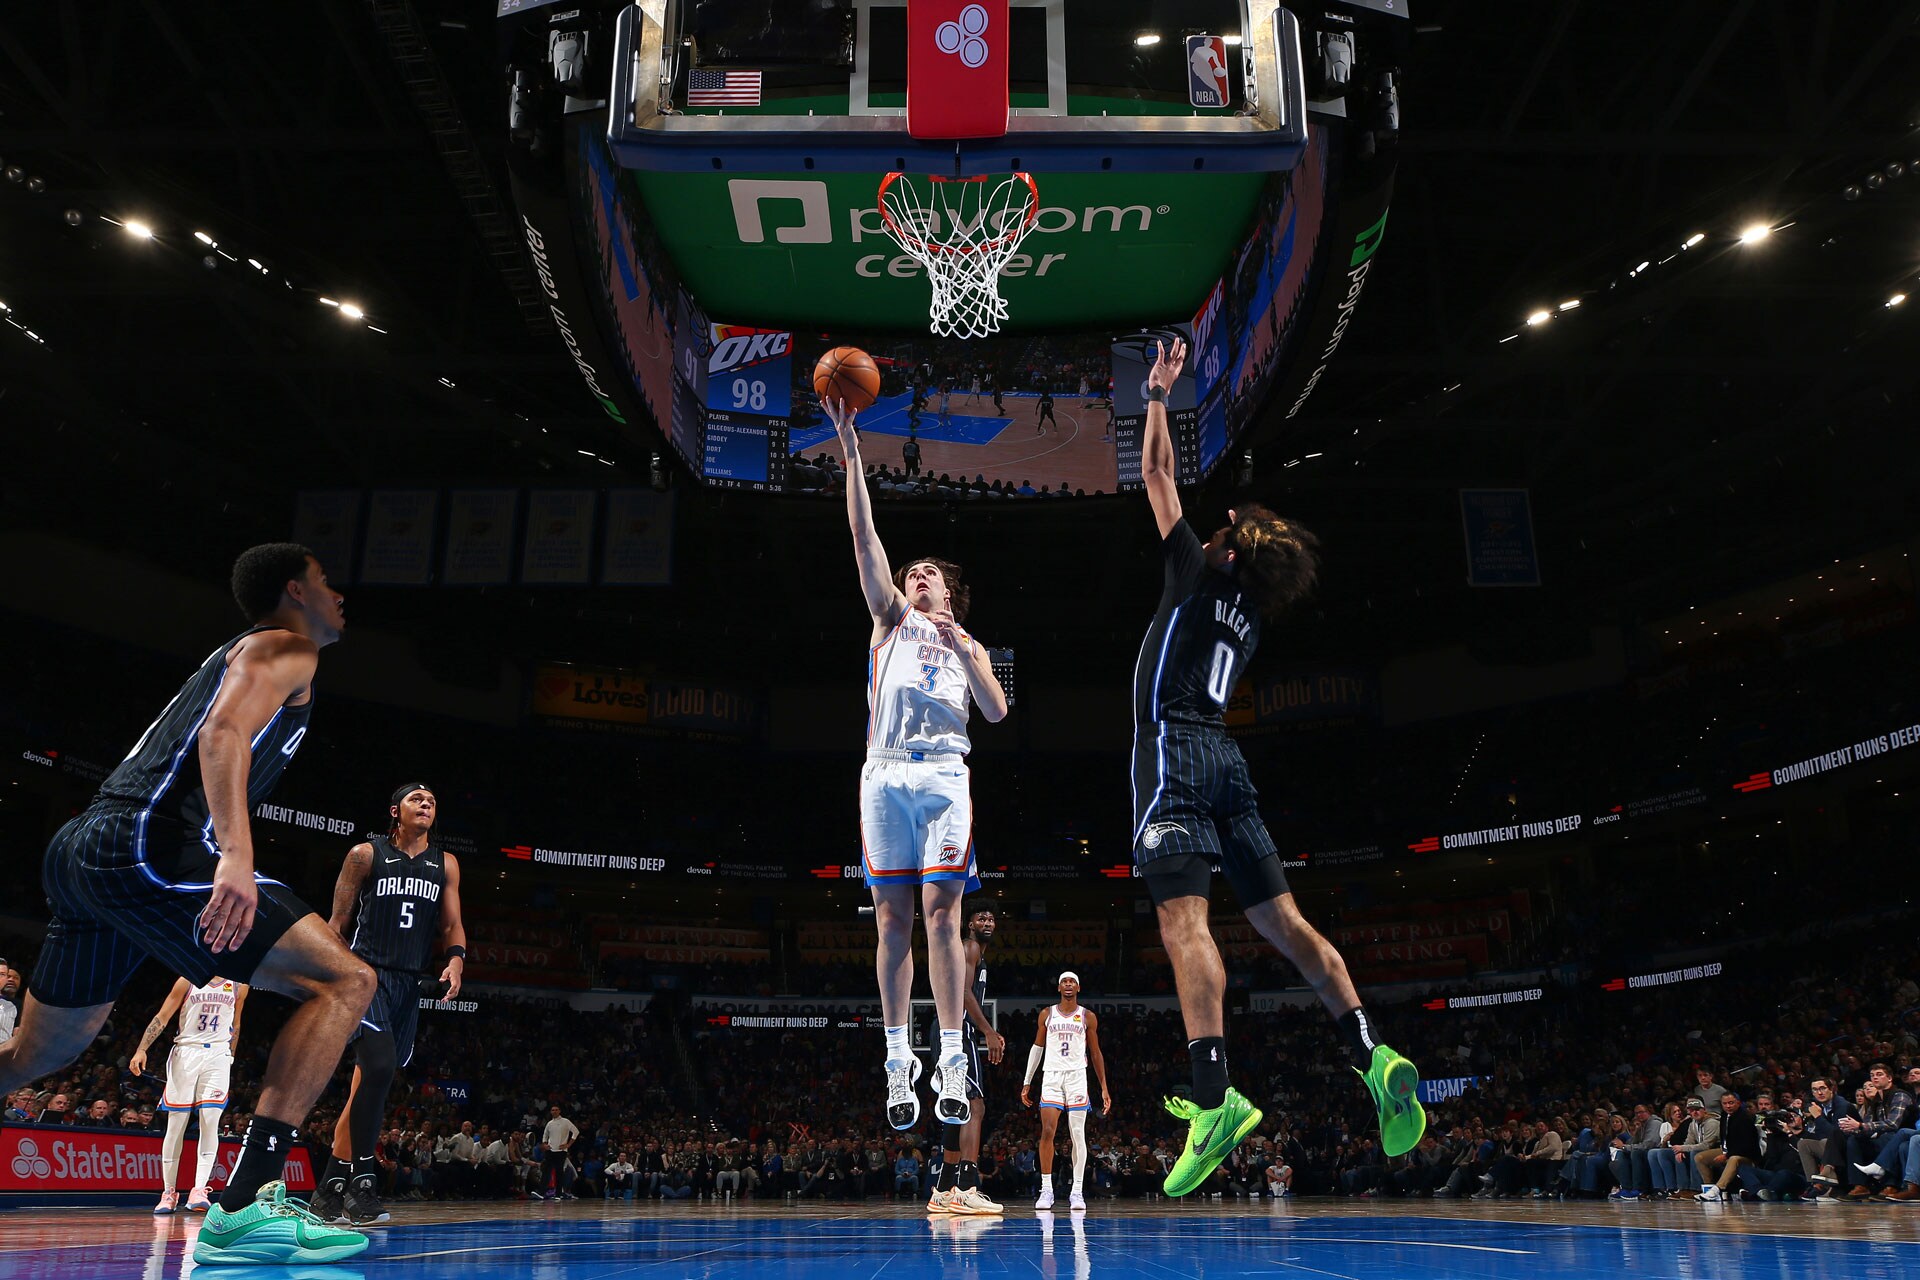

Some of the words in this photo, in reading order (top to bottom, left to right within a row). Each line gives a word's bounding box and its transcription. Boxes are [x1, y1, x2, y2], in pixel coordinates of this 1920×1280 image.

[1195, 91, 1215, 103] NBA
[522, 214, 559, 299] center
[1321, 257, 1371, 360] paycom
[709, 332, 790, 374] OKC
[685, 347, 698, 390] 91
[1204, 344, 1220, 390] 98
[732, 378, 767, 411] 98
[708, 413, 730, 421] PLAYER
[707, 424, 768, 436] GILGEOUS-ALEXANDER
[706, 445, 721, 453] DORT
[1117, 440, 1133, 448] ISAAC
[1215, 600, 1250, 641] BLACK
[901, 626, 943, 646] OKLA
[917, 643, 953, 666] CITY
[917, 662, 940, 693] 3
[1208, 642, 1233, 703] 0
[653, 686, 704, 718] LOUD
[712, 687, 753, 725] CITY
[1260, 681, 1312, 717] LOUD
[1318, 674, 1364, 704] CITY
[22, 750, 53, 766] devon
[1773, 746, 1853, 786] COMMITMENT
[1853, 735, 1889, 760] RUNS
[1889, 724, 1920, 750] DEEP
[256, 802, 295, 824] TMENT
[295, 810, 325, 831] RUNS
[327, 818, 355, 837] DEEP
[1593, 814, 1620, 825] devon
[1443, 825, 1520, 850] COMMITMENT
[1522, 820, 1554, 839] RUNS
[1556, 814, 1582, 834] DEEP
[534, 848, 608, 868] COMMITMENT
[608, 854, 637, 870] RUNS
[639, 857, 665, 871] DEEP
[686, 865, 712, 875] devon
[1281, 860, 1306, 868] devon
[980, 870, 1005, 879] devon
[376, 877, 440, 902] ORLANDO
[400, 902, 413, 928] 5
[471, 943, 549, 967] ASINO
[1628, 968, 1683, 989] COMMITMENT
[1683, 965, 1703, 980] RUNS
[1704, 962, 1722, 977] DEEP
[190, 992, 235, 1007] OKLAHOMA
[202, 1003, 221, 1013] CITY
[435, 999, 457, 1011] RUNS
[458, 1001, 478, 1013] DEEP
[1449, 993, 1502, 1009] COMMITMENT
[1503, 990, 1523, 1004] RUNS
[1524, 988, 1542, 1000] DEEP
[198, 1014, 219, 1031] 34
[731, 1016, 785, 1027] COMMITMENT
[786, 1016, 808, 1028] RUNS
[808, 1017, 828, 1028] DEEP
[837, 1020, 859, 1028] devon
[1049, 1023, 1084, 1036] OKLAHOMA
[1058, 1032, 1073, 1041] CITY
[1061, 1042, 1070, 1056] 2
